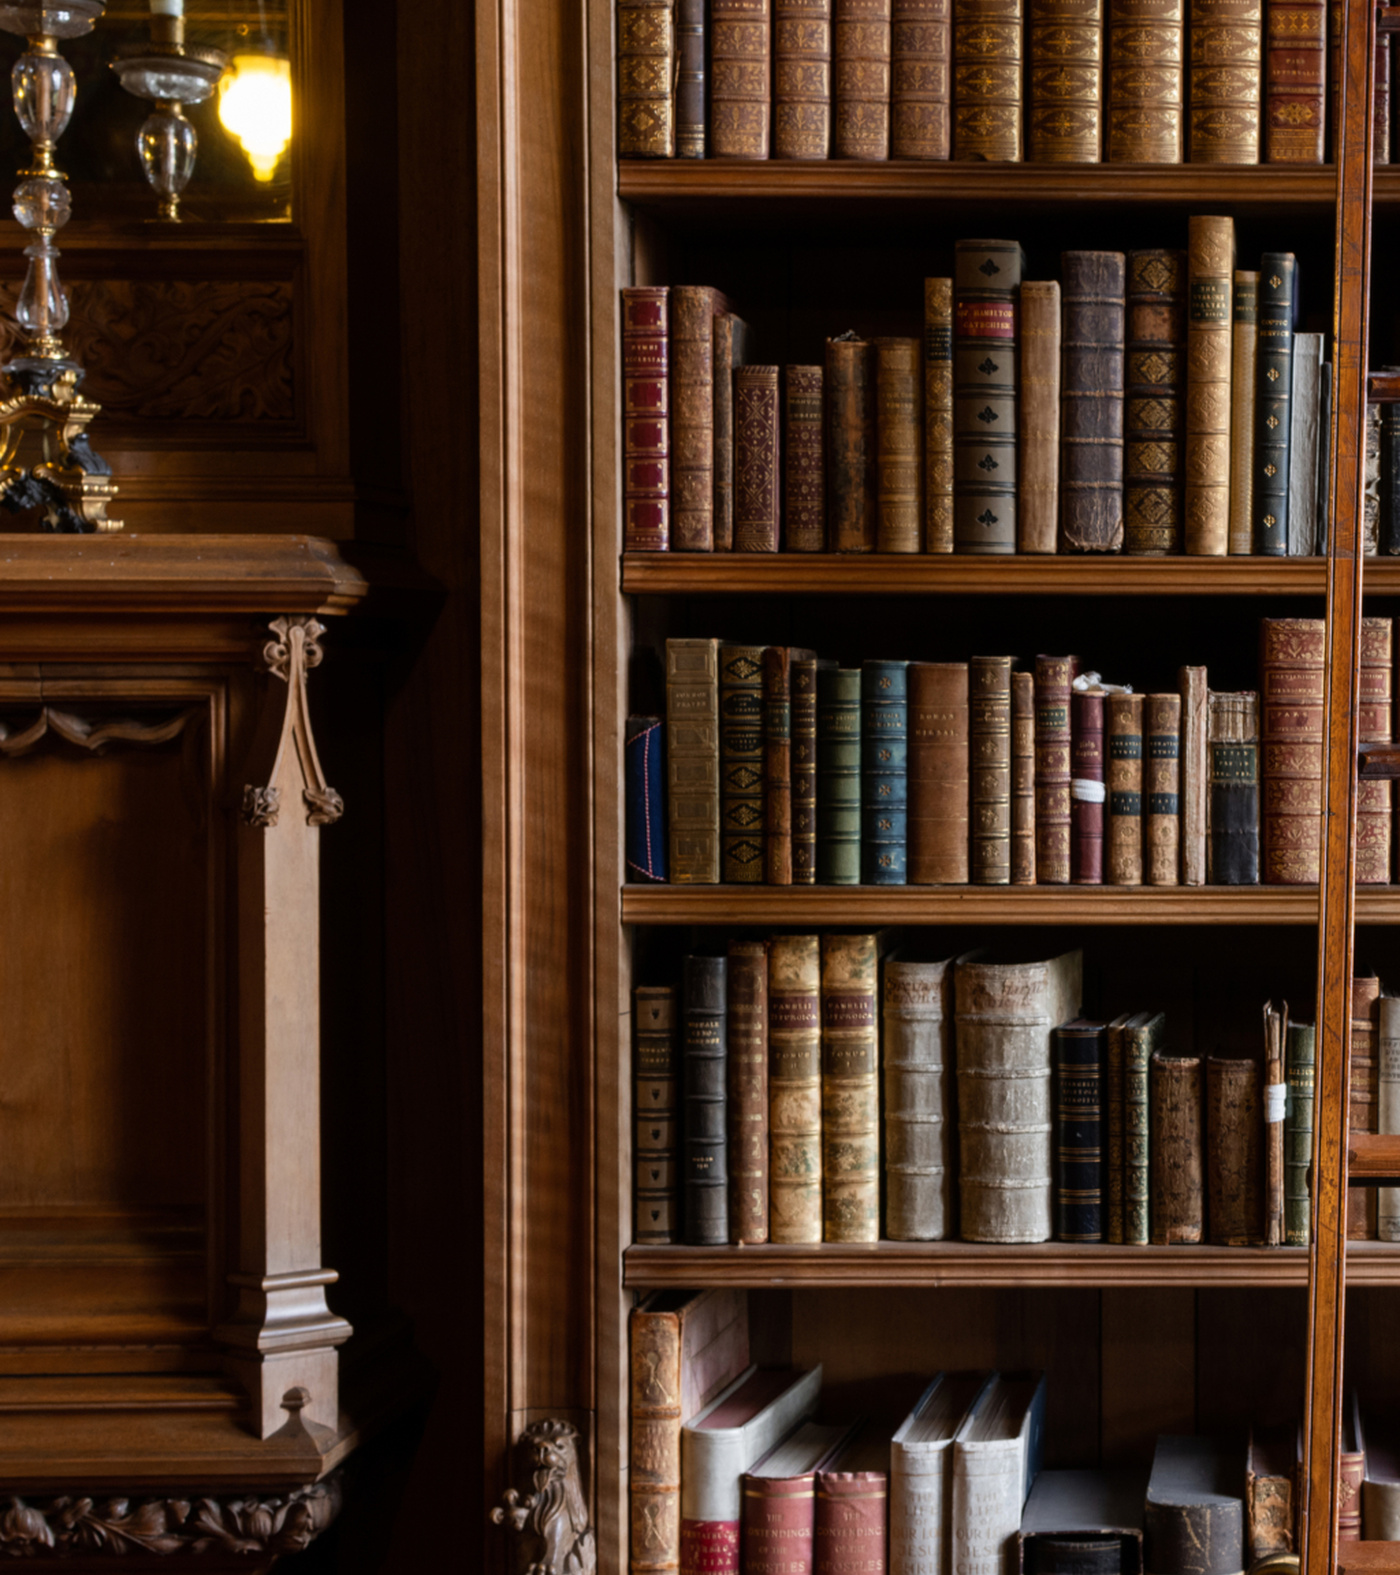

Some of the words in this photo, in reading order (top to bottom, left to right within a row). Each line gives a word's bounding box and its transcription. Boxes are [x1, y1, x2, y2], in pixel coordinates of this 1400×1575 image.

[766, 1514, 783, 1523] THE
[897, 1546, 941, 1558] JESU
[960, 1546, 995, 1559] JES
[956, 1561, 998, 1575] CHRI
